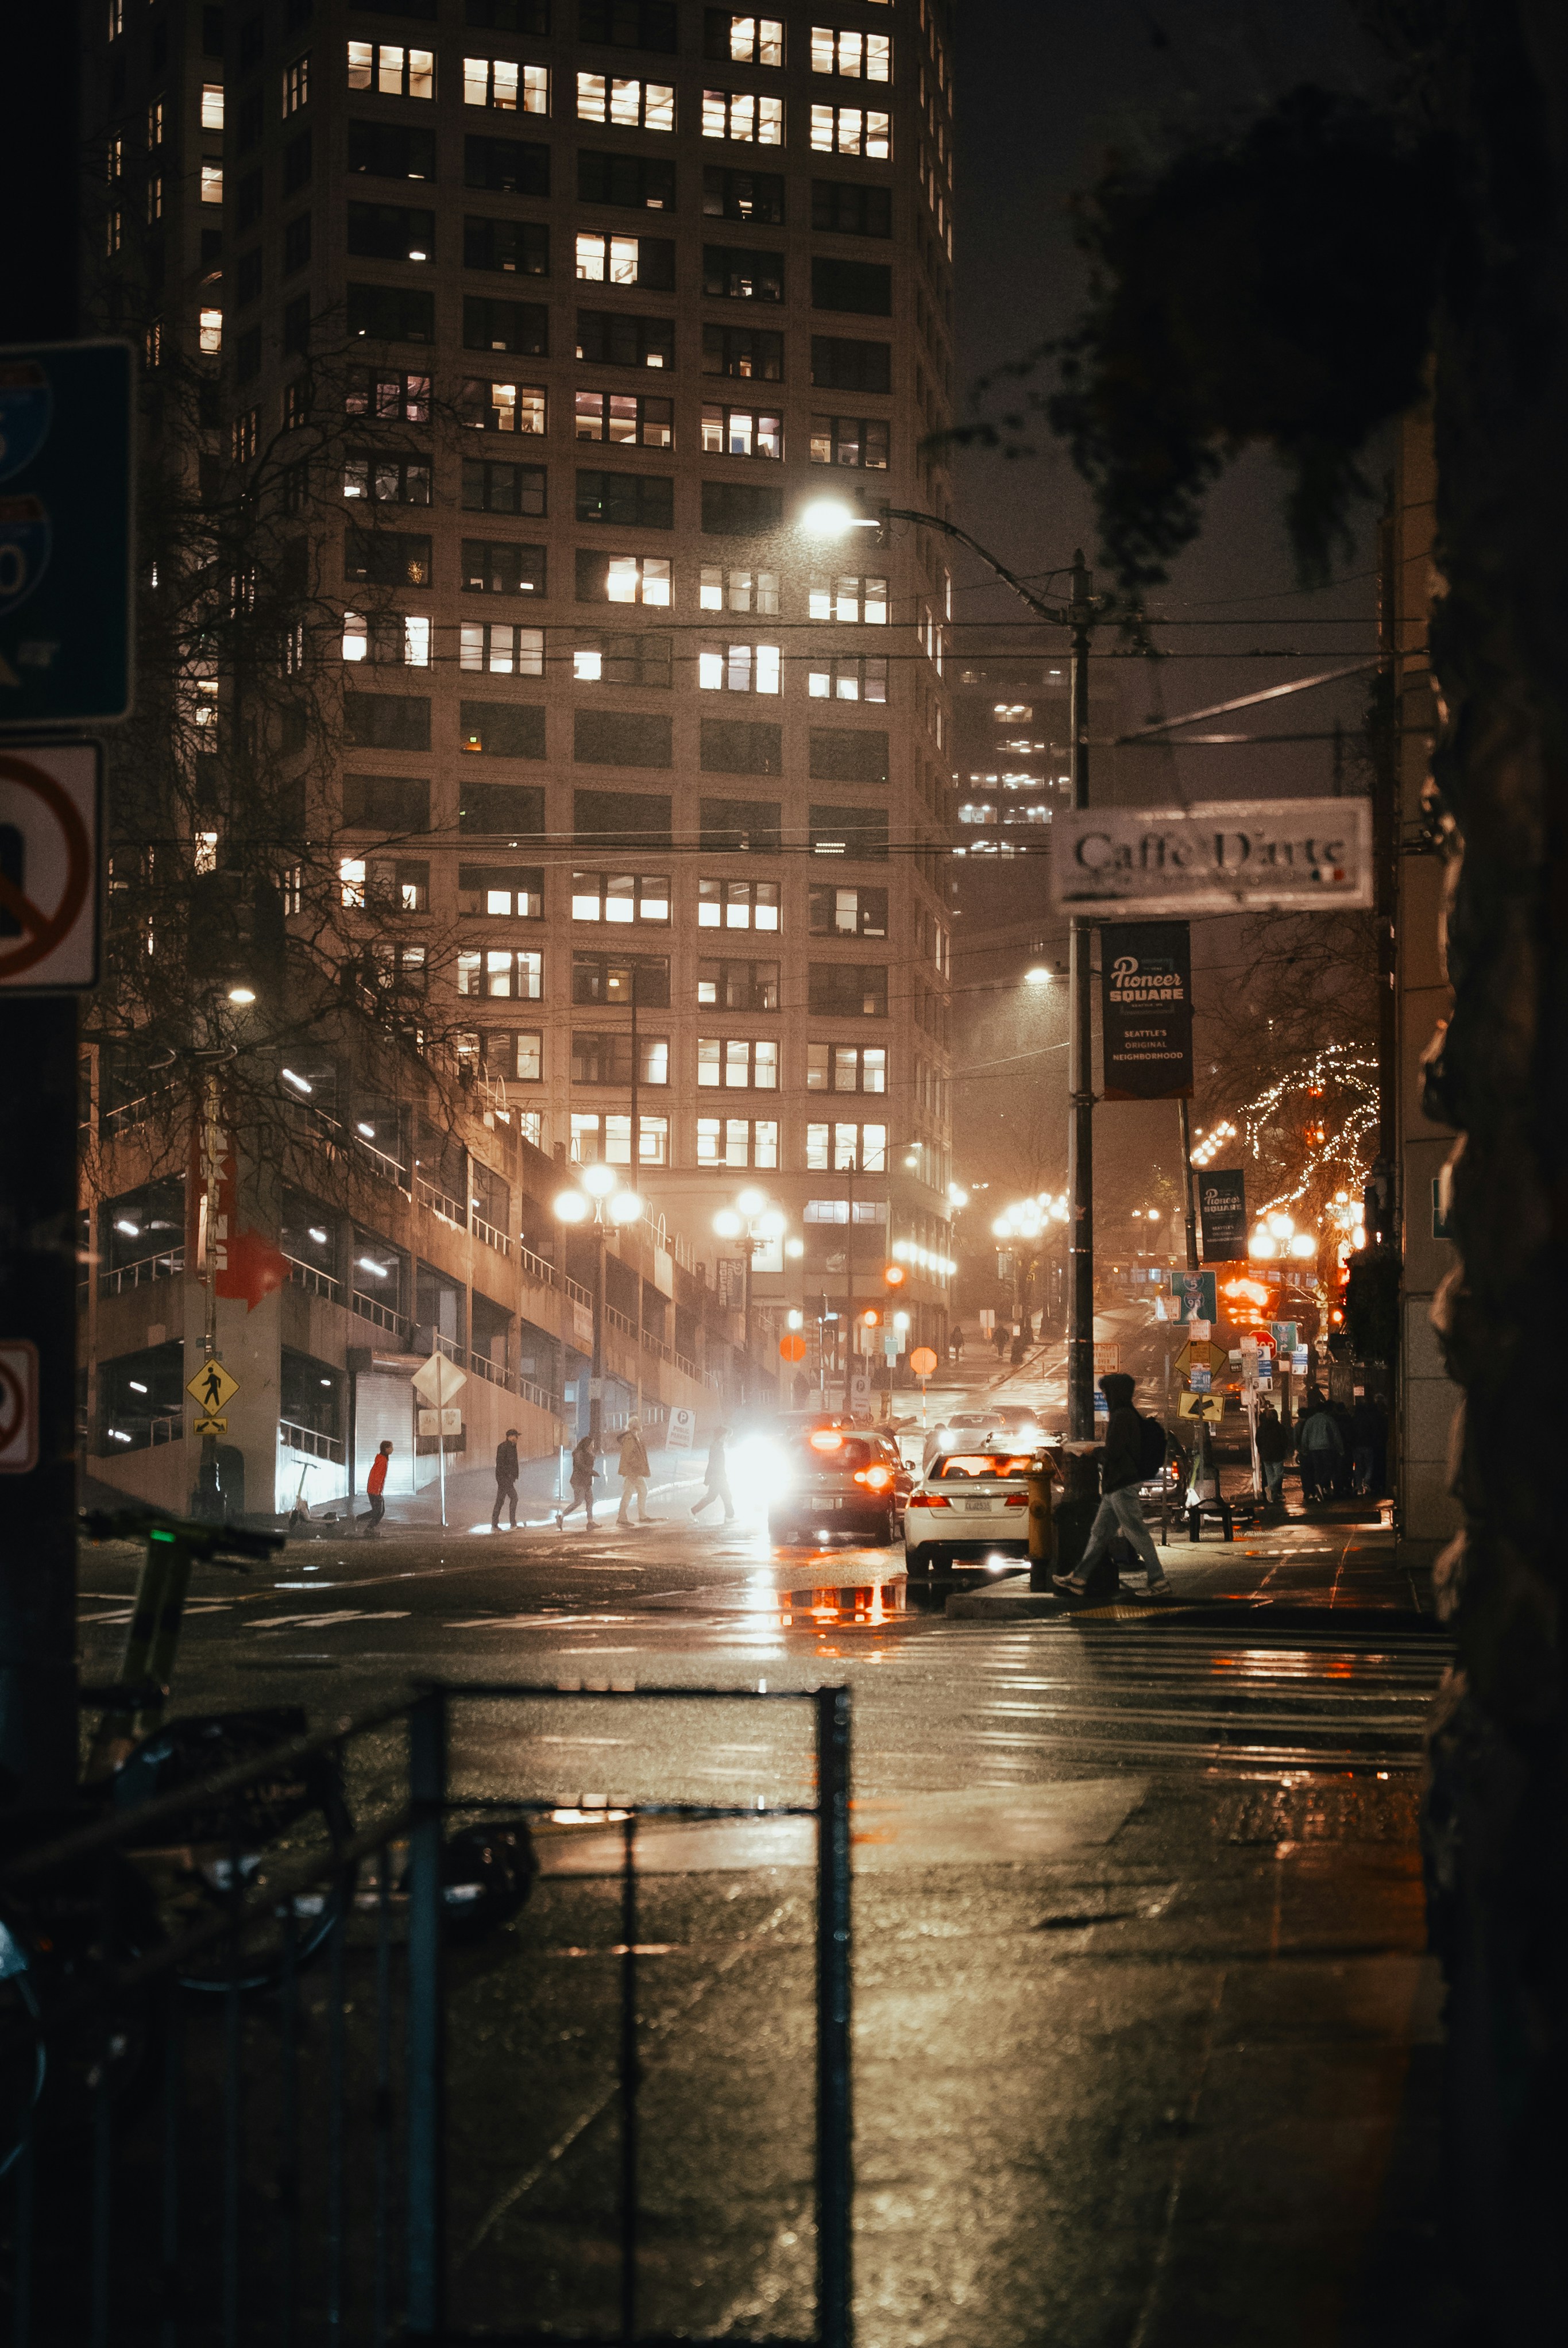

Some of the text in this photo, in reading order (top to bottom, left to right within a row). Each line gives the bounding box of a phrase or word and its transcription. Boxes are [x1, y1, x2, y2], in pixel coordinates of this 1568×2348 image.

[0, 543, 26, 596] 0
[1110, 956, 1183, 988] Pioneer
[1110, 988, 1184, 1003] SQUARE
[1124, 1030, 1167, 1038] SEATTLE'S
[1113, 1052, 1183, 1061] NEIGHBORHOOD
[1204, 1204, 1242, 1212] SQUARE
[1190, 1280, 1198, 1289] 5
[1188, 1299, 1201, 1308] 90
